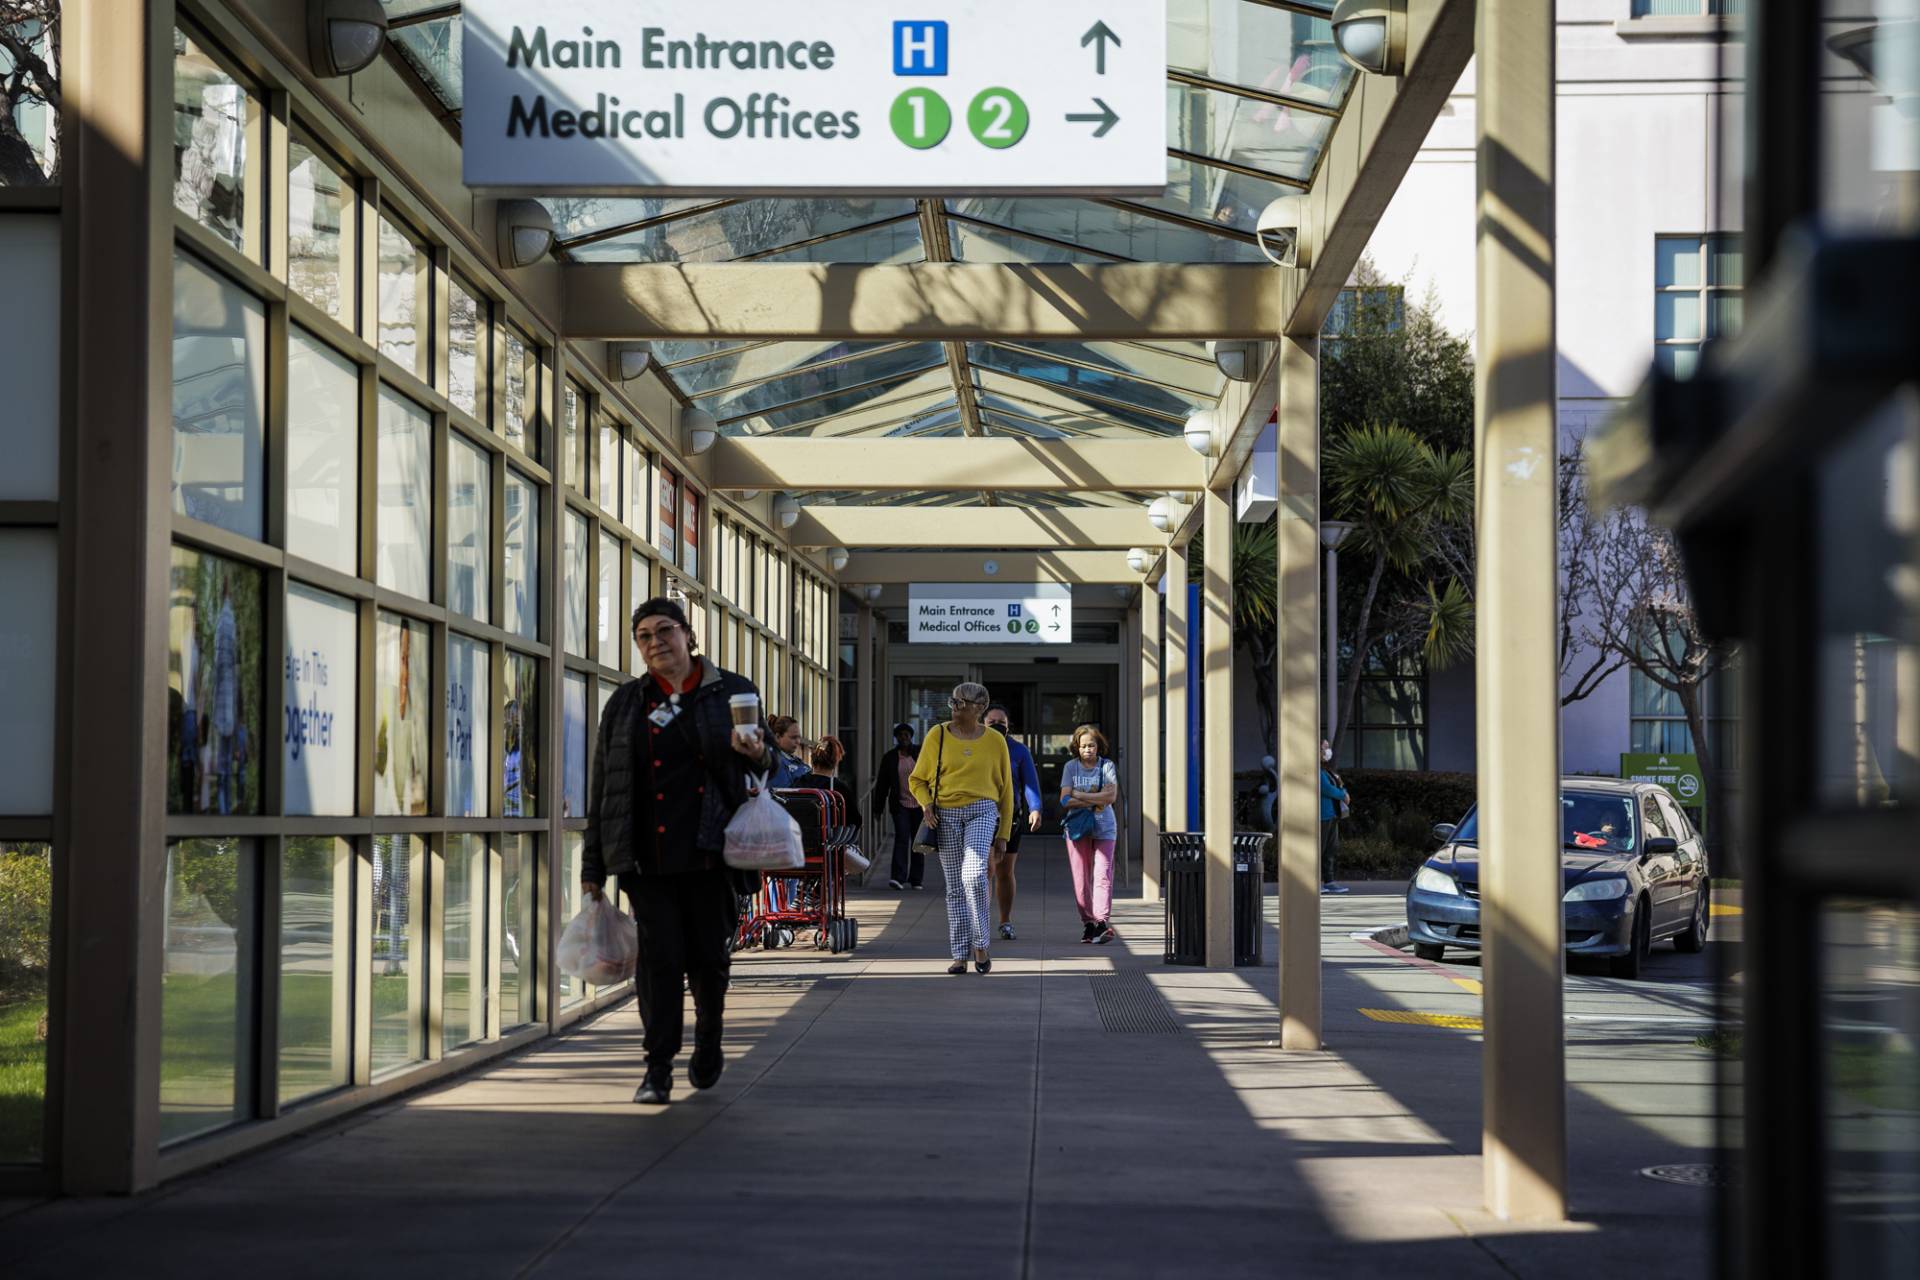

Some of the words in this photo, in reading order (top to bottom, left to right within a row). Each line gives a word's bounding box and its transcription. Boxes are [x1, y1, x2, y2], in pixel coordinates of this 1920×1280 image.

[506, 25, 622, 70] Main
[641, 26, 836, 71] Entrance
[902, 26, 935, 68] H
[506, 93, 685, 140] Medical
[703, 94, 860, 140] Offices
[919, 605, 946, 616] Main
[950, 605, 995, 616] Entrance
[919, 619, 960, 632] Medical
[964, 619, 1001, 632] Offices
[284, 689, 333, 761] ogether
[1658, 775, 1676, 784] FREE
